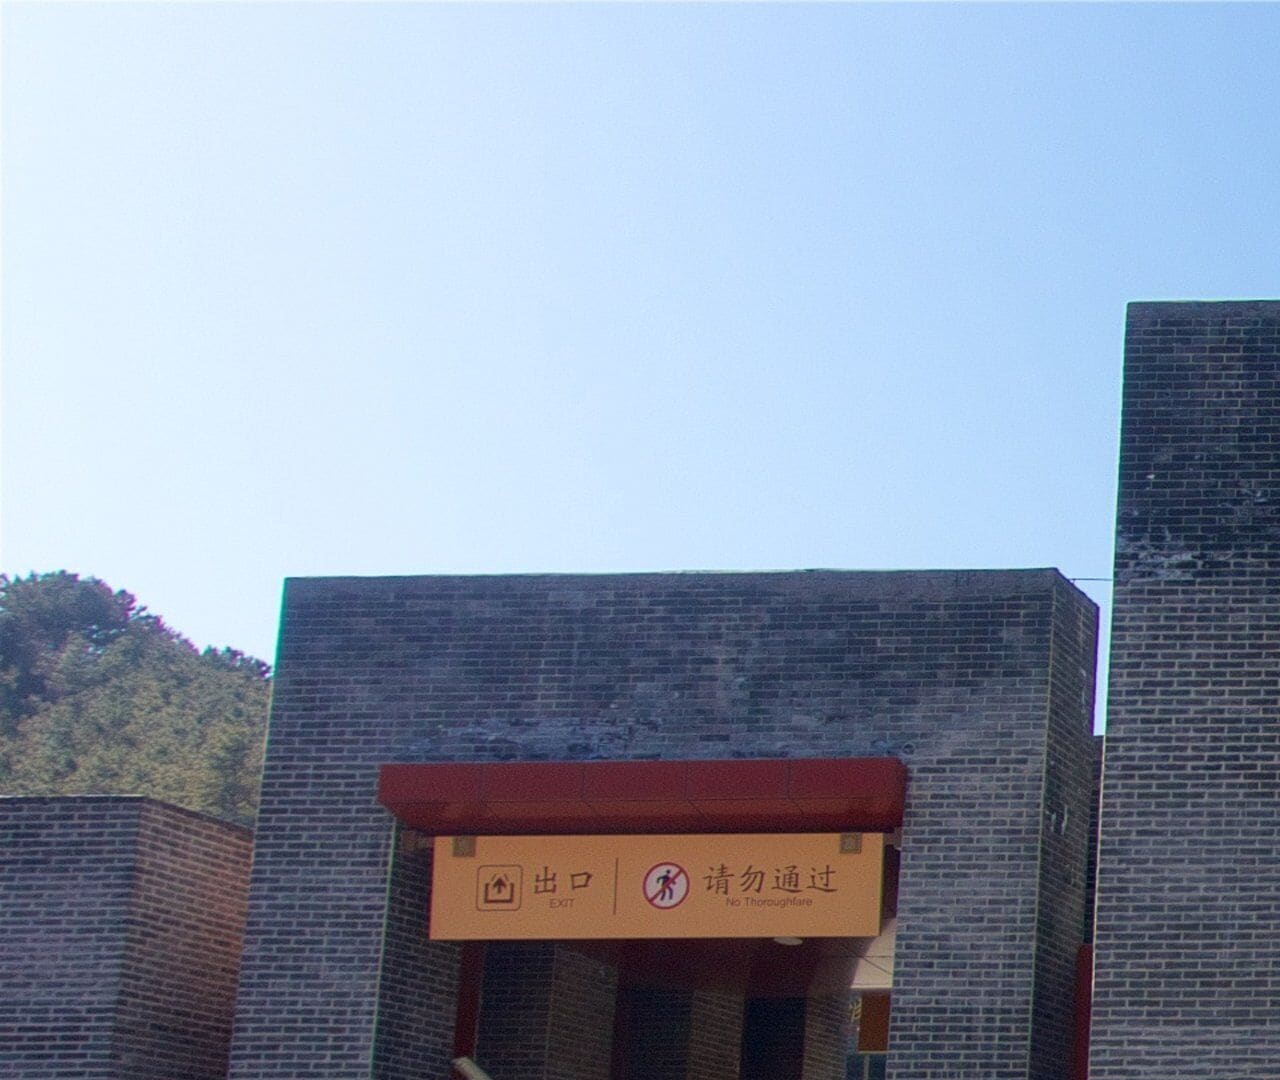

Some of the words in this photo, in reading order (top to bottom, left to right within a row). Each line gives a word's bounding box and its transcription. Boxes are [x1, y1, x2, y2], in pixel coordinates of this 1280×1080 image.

[533, 866, 593, 894] 出口
[702, 863, 838, 895] 请勿通过
[549, 898, 575, 909] EXIT
[726, 897, 741, 907] No
[743, 896, 813, 909] Thoroughfare
